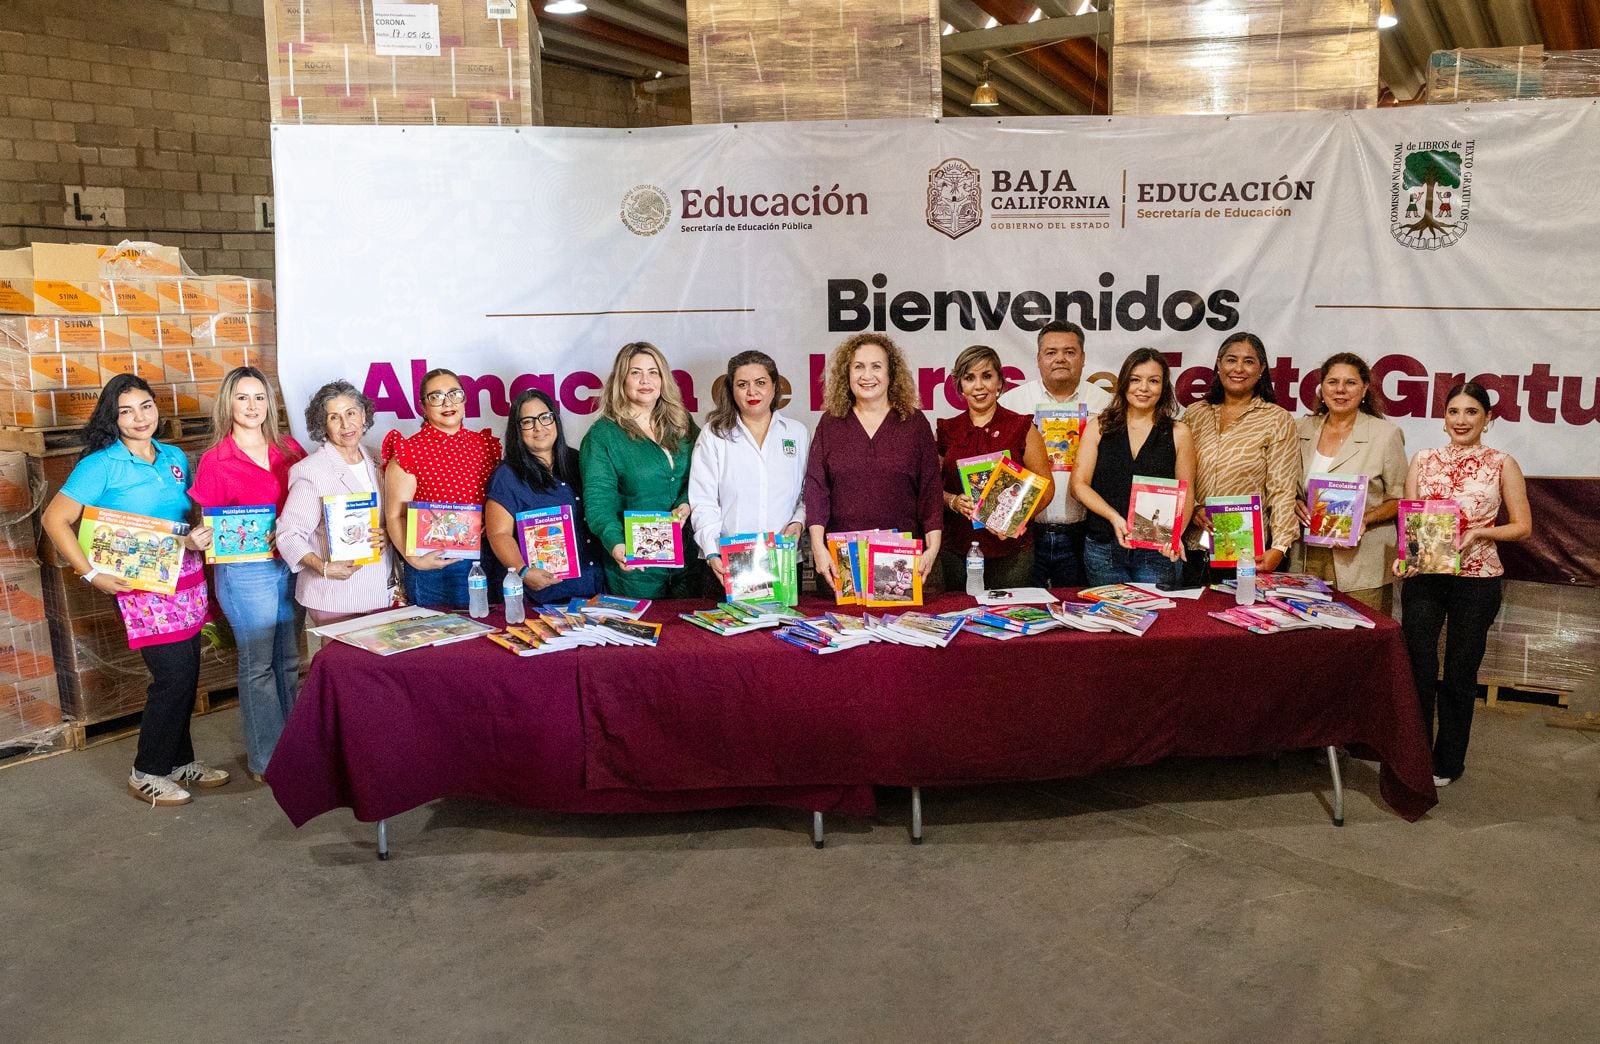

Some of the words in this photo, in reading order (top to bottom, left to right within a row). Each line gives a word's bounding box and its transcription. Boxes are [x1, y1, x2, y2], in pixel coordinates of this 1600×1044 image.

[1406, 141, 1417, 151] de
[1418, 140, 1450, 150] LIBROS
[1452, 140, 1462, 149] de
[1464, 140, 1475, 169] TEXTO
[1391, 142, 1403, 181] NACIONAL
[991, 169, 1077, 196] BAJA
[1136, 174, 1316, 204] EDUCACIÓN
[1461, 172, 1472, 220] GRATUITOS
[73, 192, 93, 222] L
[681, 184, 868, 219] Educación
[991, 195, 1111, 211] CALIFORNIA
[1136, 207, 1200, 220] Secretaría
[1204, 207, 1221, 219] de
[1224, 205, 1292, 219] Educación
[1390, 182, 1401, 223] COMISIÓN
[680, 223, 723, 233] Secretaría
[724, 223, 736, 232] de
[737, 222, 780, 232] Educación
[781, 221, 813, 231] Pública
[990, 221, 1043, 231] GOBIERNO
[1046, 221, 1067, 230] DEL
[1069, 221, 1111, 230] ESTADO
[827, 271, 1240, 333] Bienvenidos
[360, 358, 699, 420] Almacn
[1327, 481, 1358, 490] Escolares
[534, 515, 564, 525] Escolares
[1223, 505, 1253, 513] Escolares
